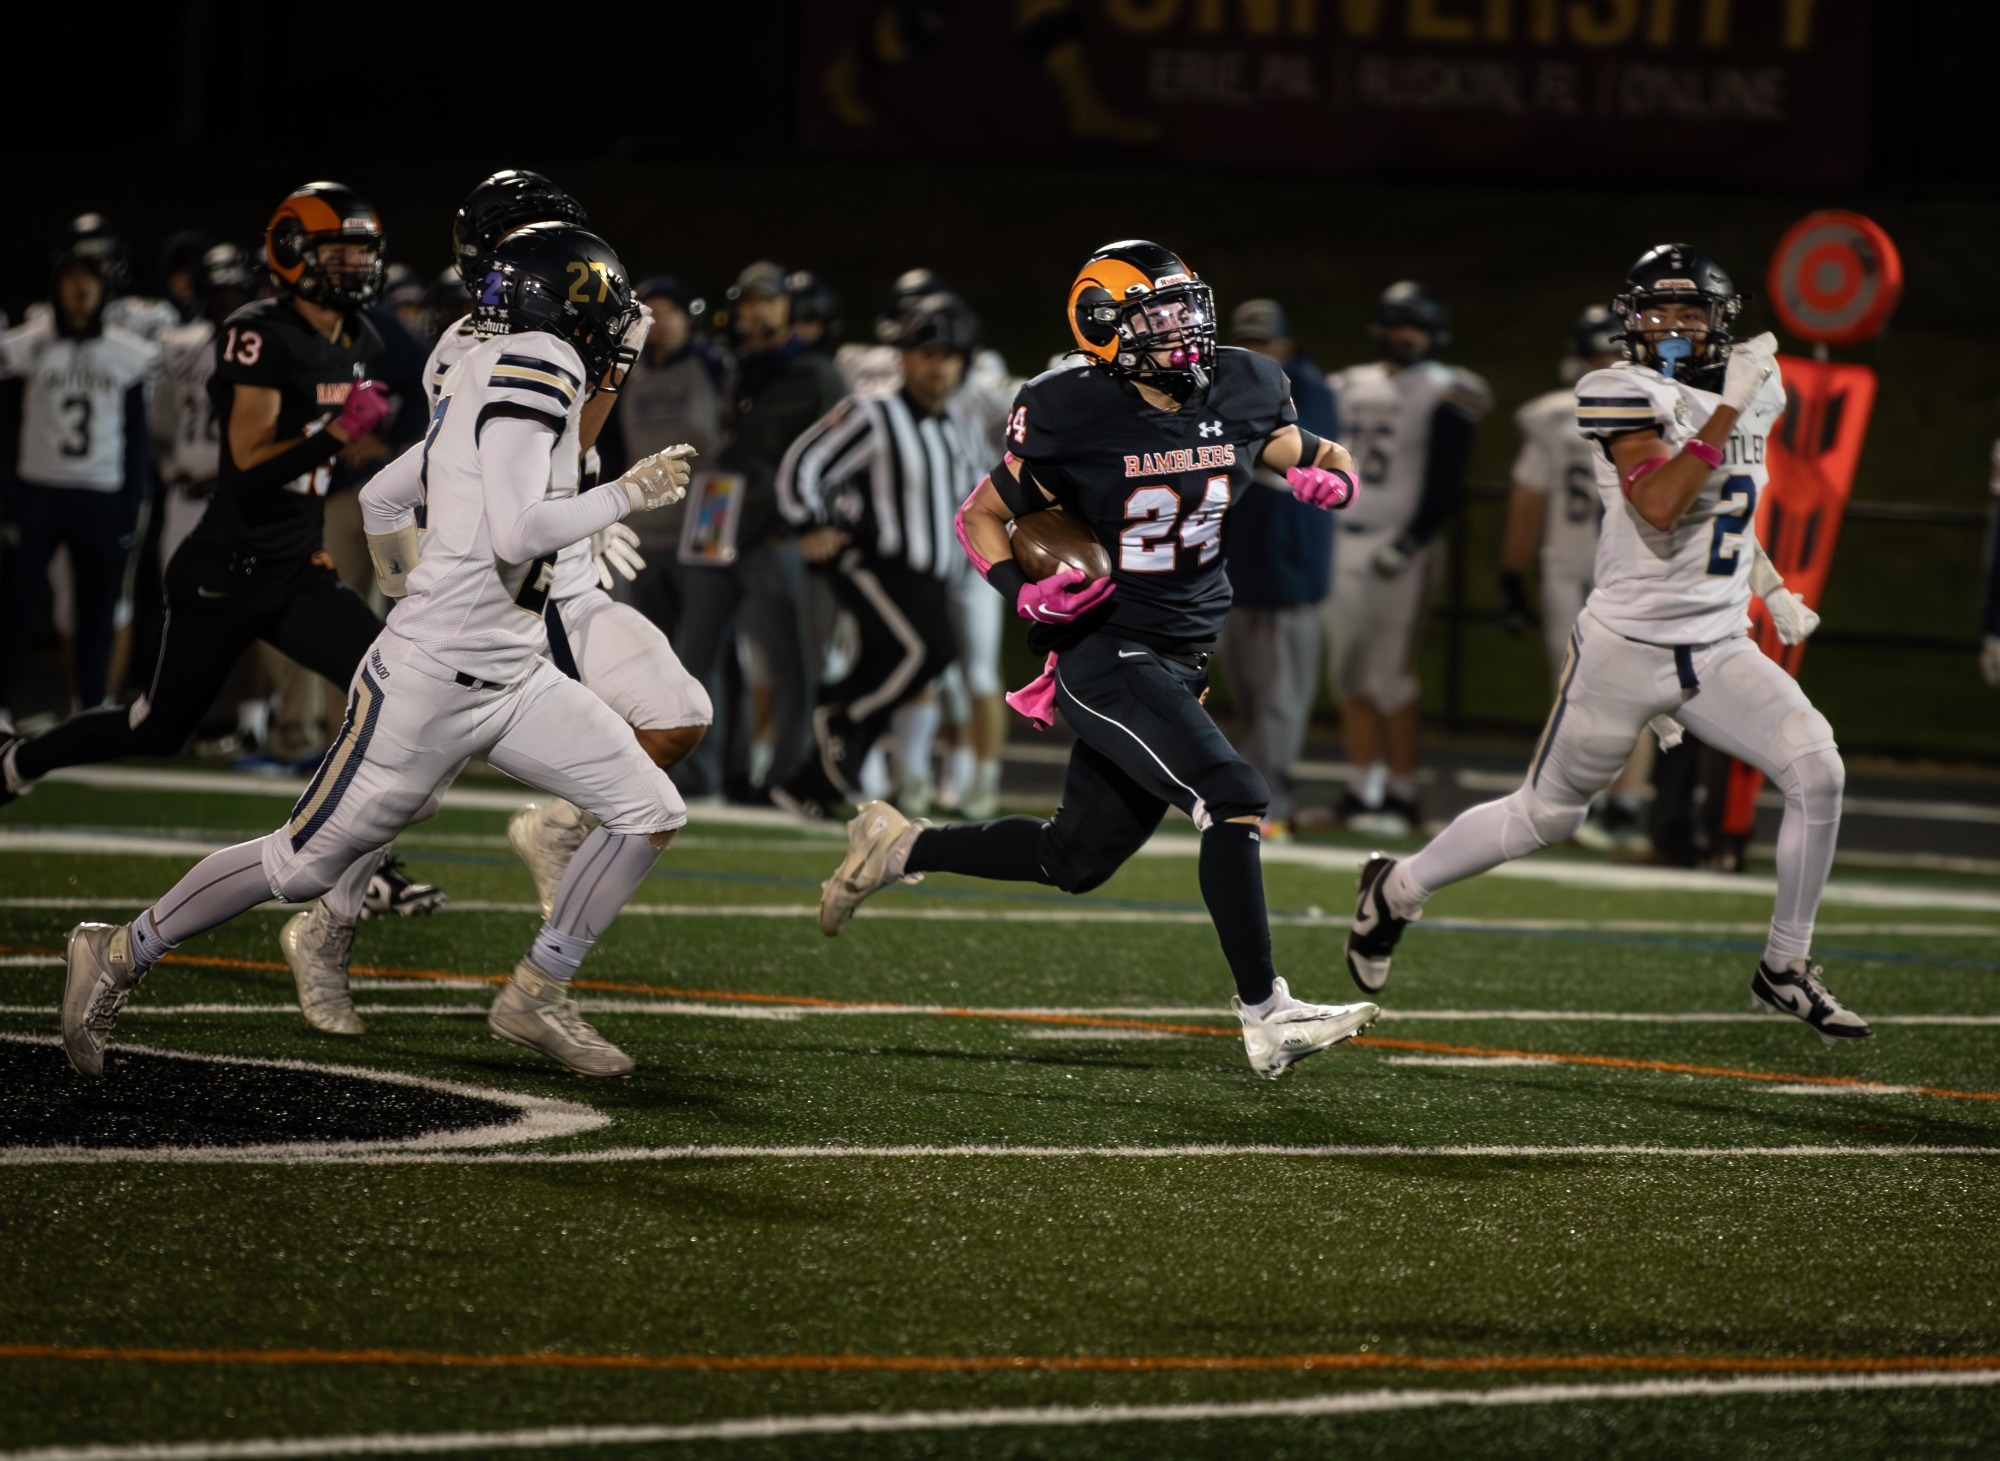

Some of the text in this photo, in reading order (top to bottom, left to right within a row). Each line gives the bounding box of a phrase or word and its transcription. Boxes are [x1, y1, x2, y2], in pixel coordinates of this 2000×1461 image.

[482, 271, 503, 306] 2
[566, 260, 610, 305] 27
[223, 327, 264, 367] 13
[62, 395, 93, 457] 3
[1124, 444, 1237, 478] RAMBLERS
[1118, 473, 1233, 574] 24
[1707, 472, 1757, 577] 2
